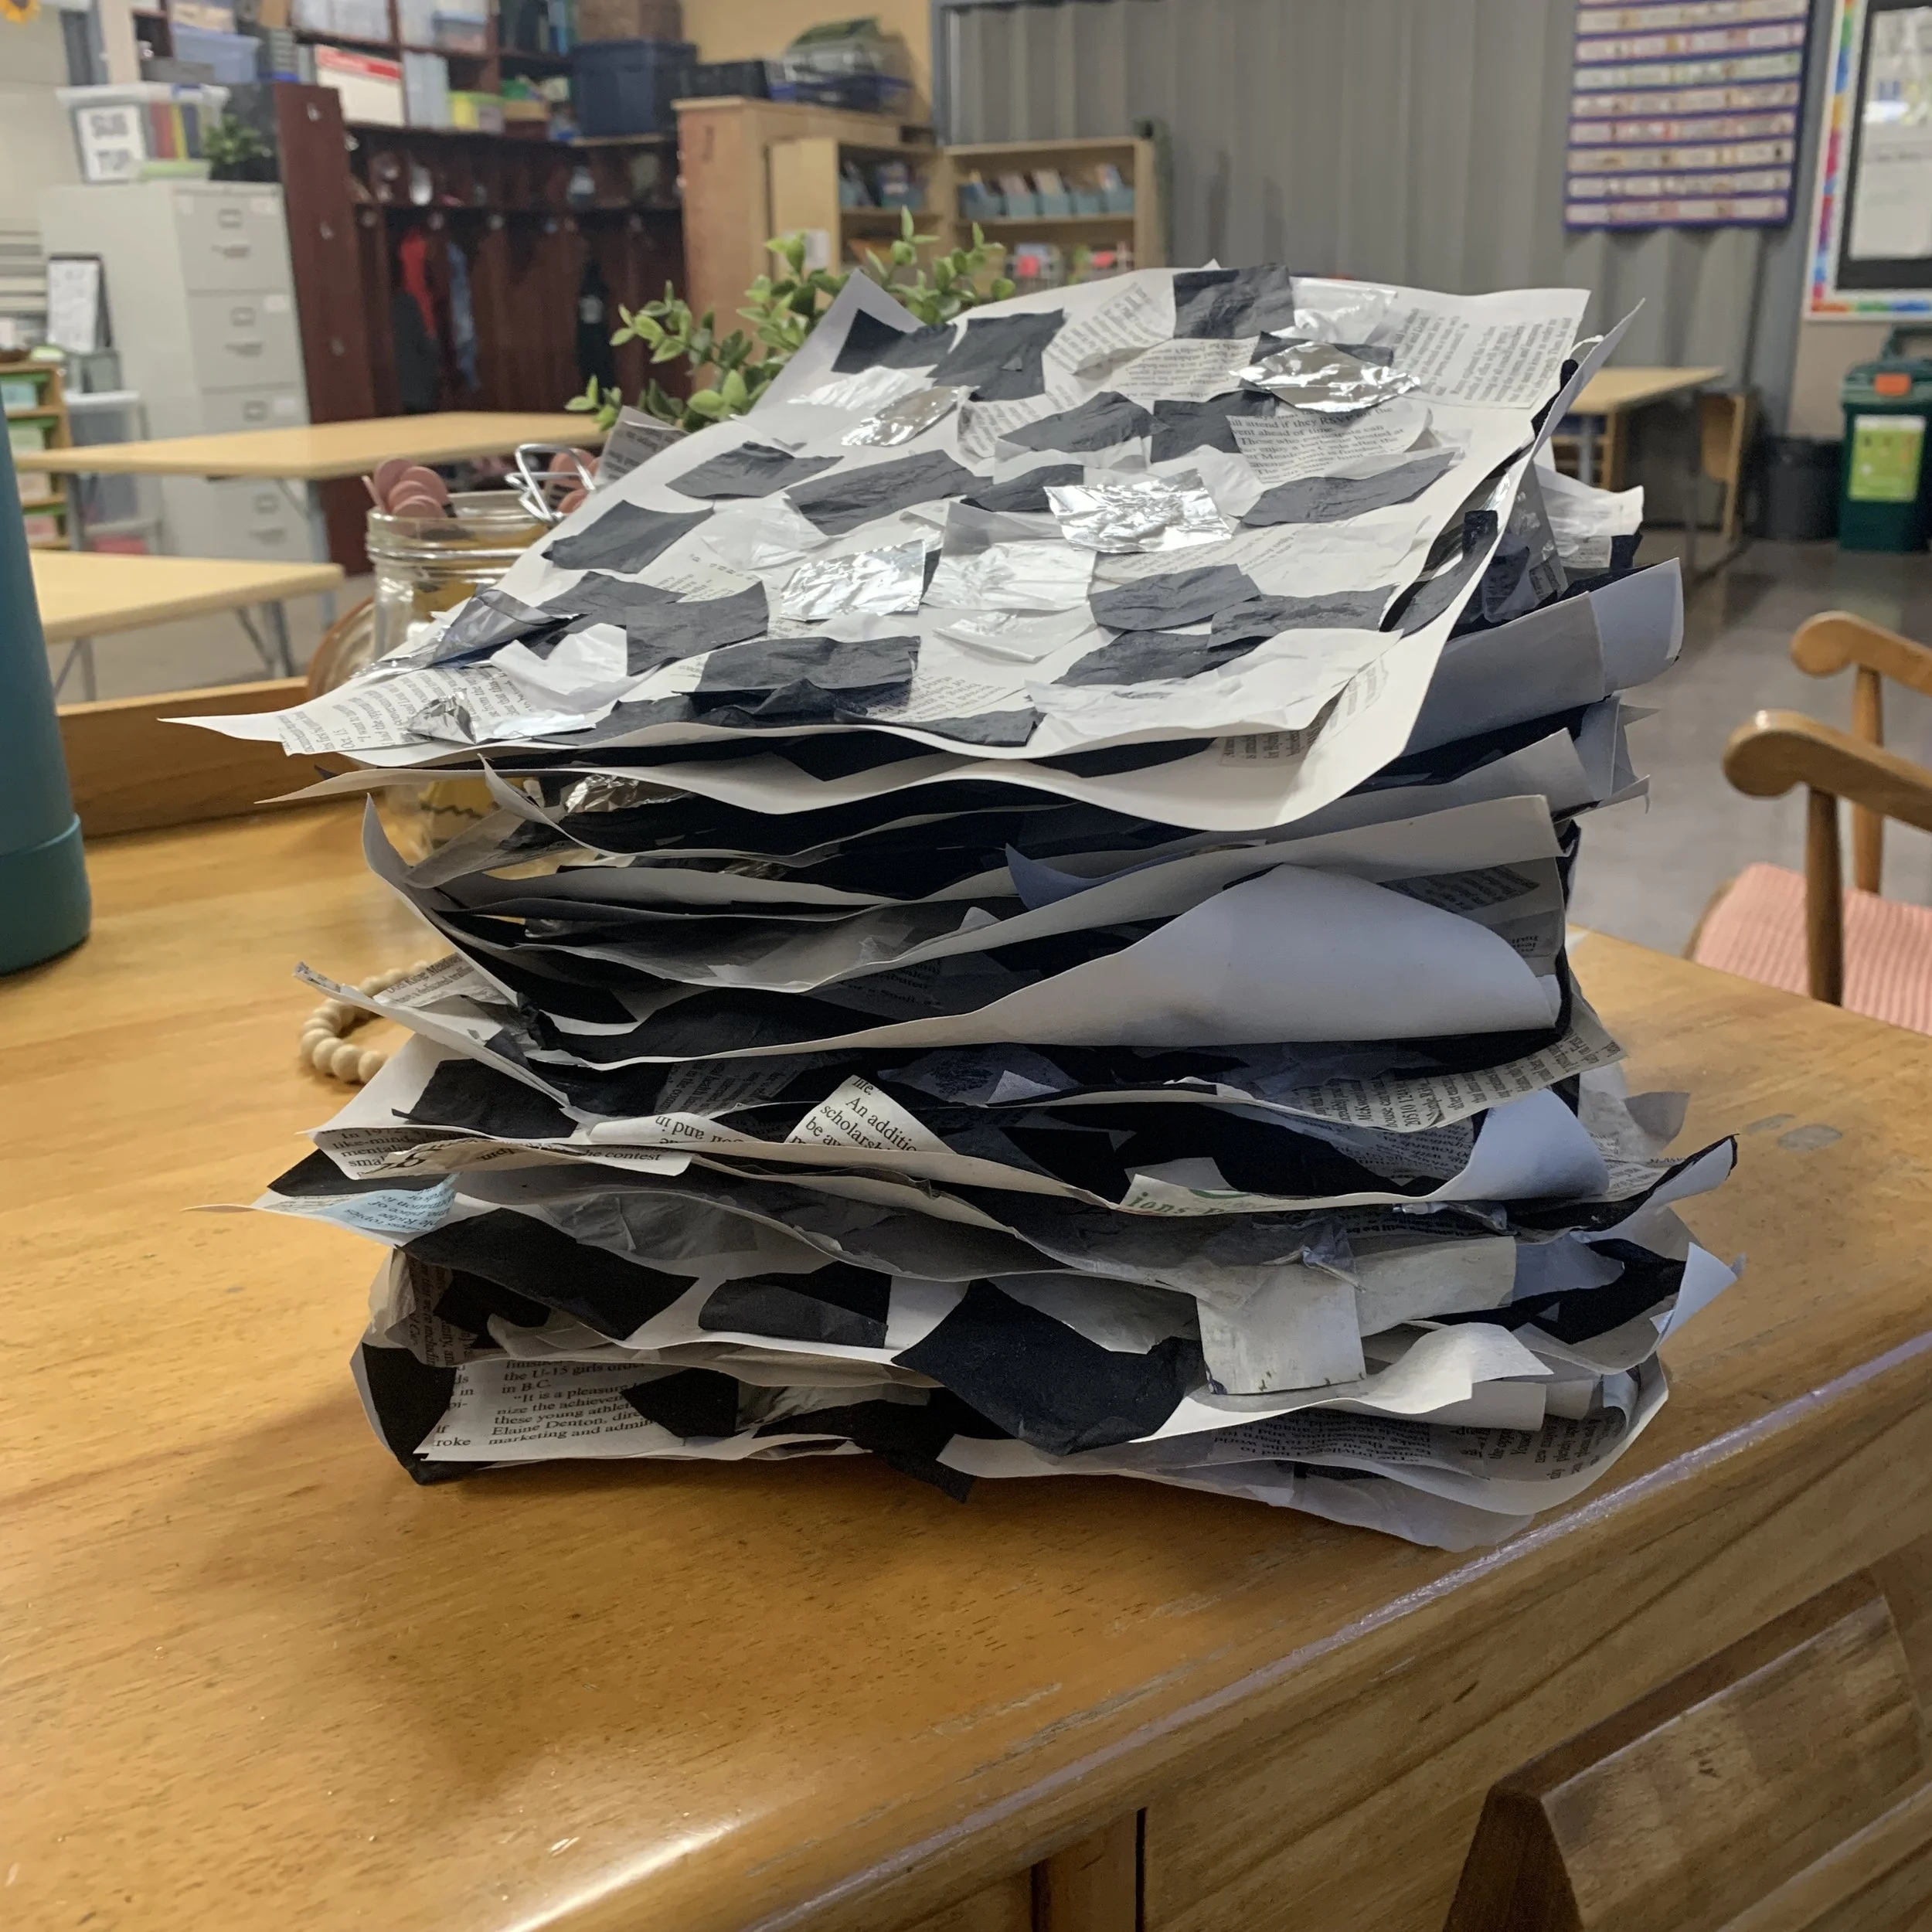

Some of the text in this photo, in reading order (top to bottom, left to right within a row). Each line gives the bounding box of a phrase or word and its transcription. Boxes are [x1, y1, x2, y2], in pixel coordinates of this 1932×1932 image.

[1293, 418, 1318, 427] they
[1319, 414, 1354, 425] RSVP
[1258, 429, 1290, 437] ahead
[1240, 437, 1273, 446] Those
[845, 1097, 869, 1118] An
[672, 1121, 705, 1140] and
[804, 1116, 823, 1138] be
[604, 1151, 662, 1162] contest
[504, 1371, 528, 1382] the
[532, 1366, 568, 1379] U-15
[572, 1362, 603, 1376] girls
[502, 1379, 552, 1394] in B.C.
[538, 1391, 550, 1400] is
[566, 1383, 628, 1400] pleasure
[497, 1406, 529, 1415] nize
[532, 1401, 556, 1412] the
[494, 1415, 533, 1425] these
[536, 1410, 584, 1423] young
[492, 1424, 541, 1436] Elaine
[546, 1418, 608, 1430] Denton,
[488, 1430, 568, 1446] marketing
[571, 1426, 601, 1437] and
